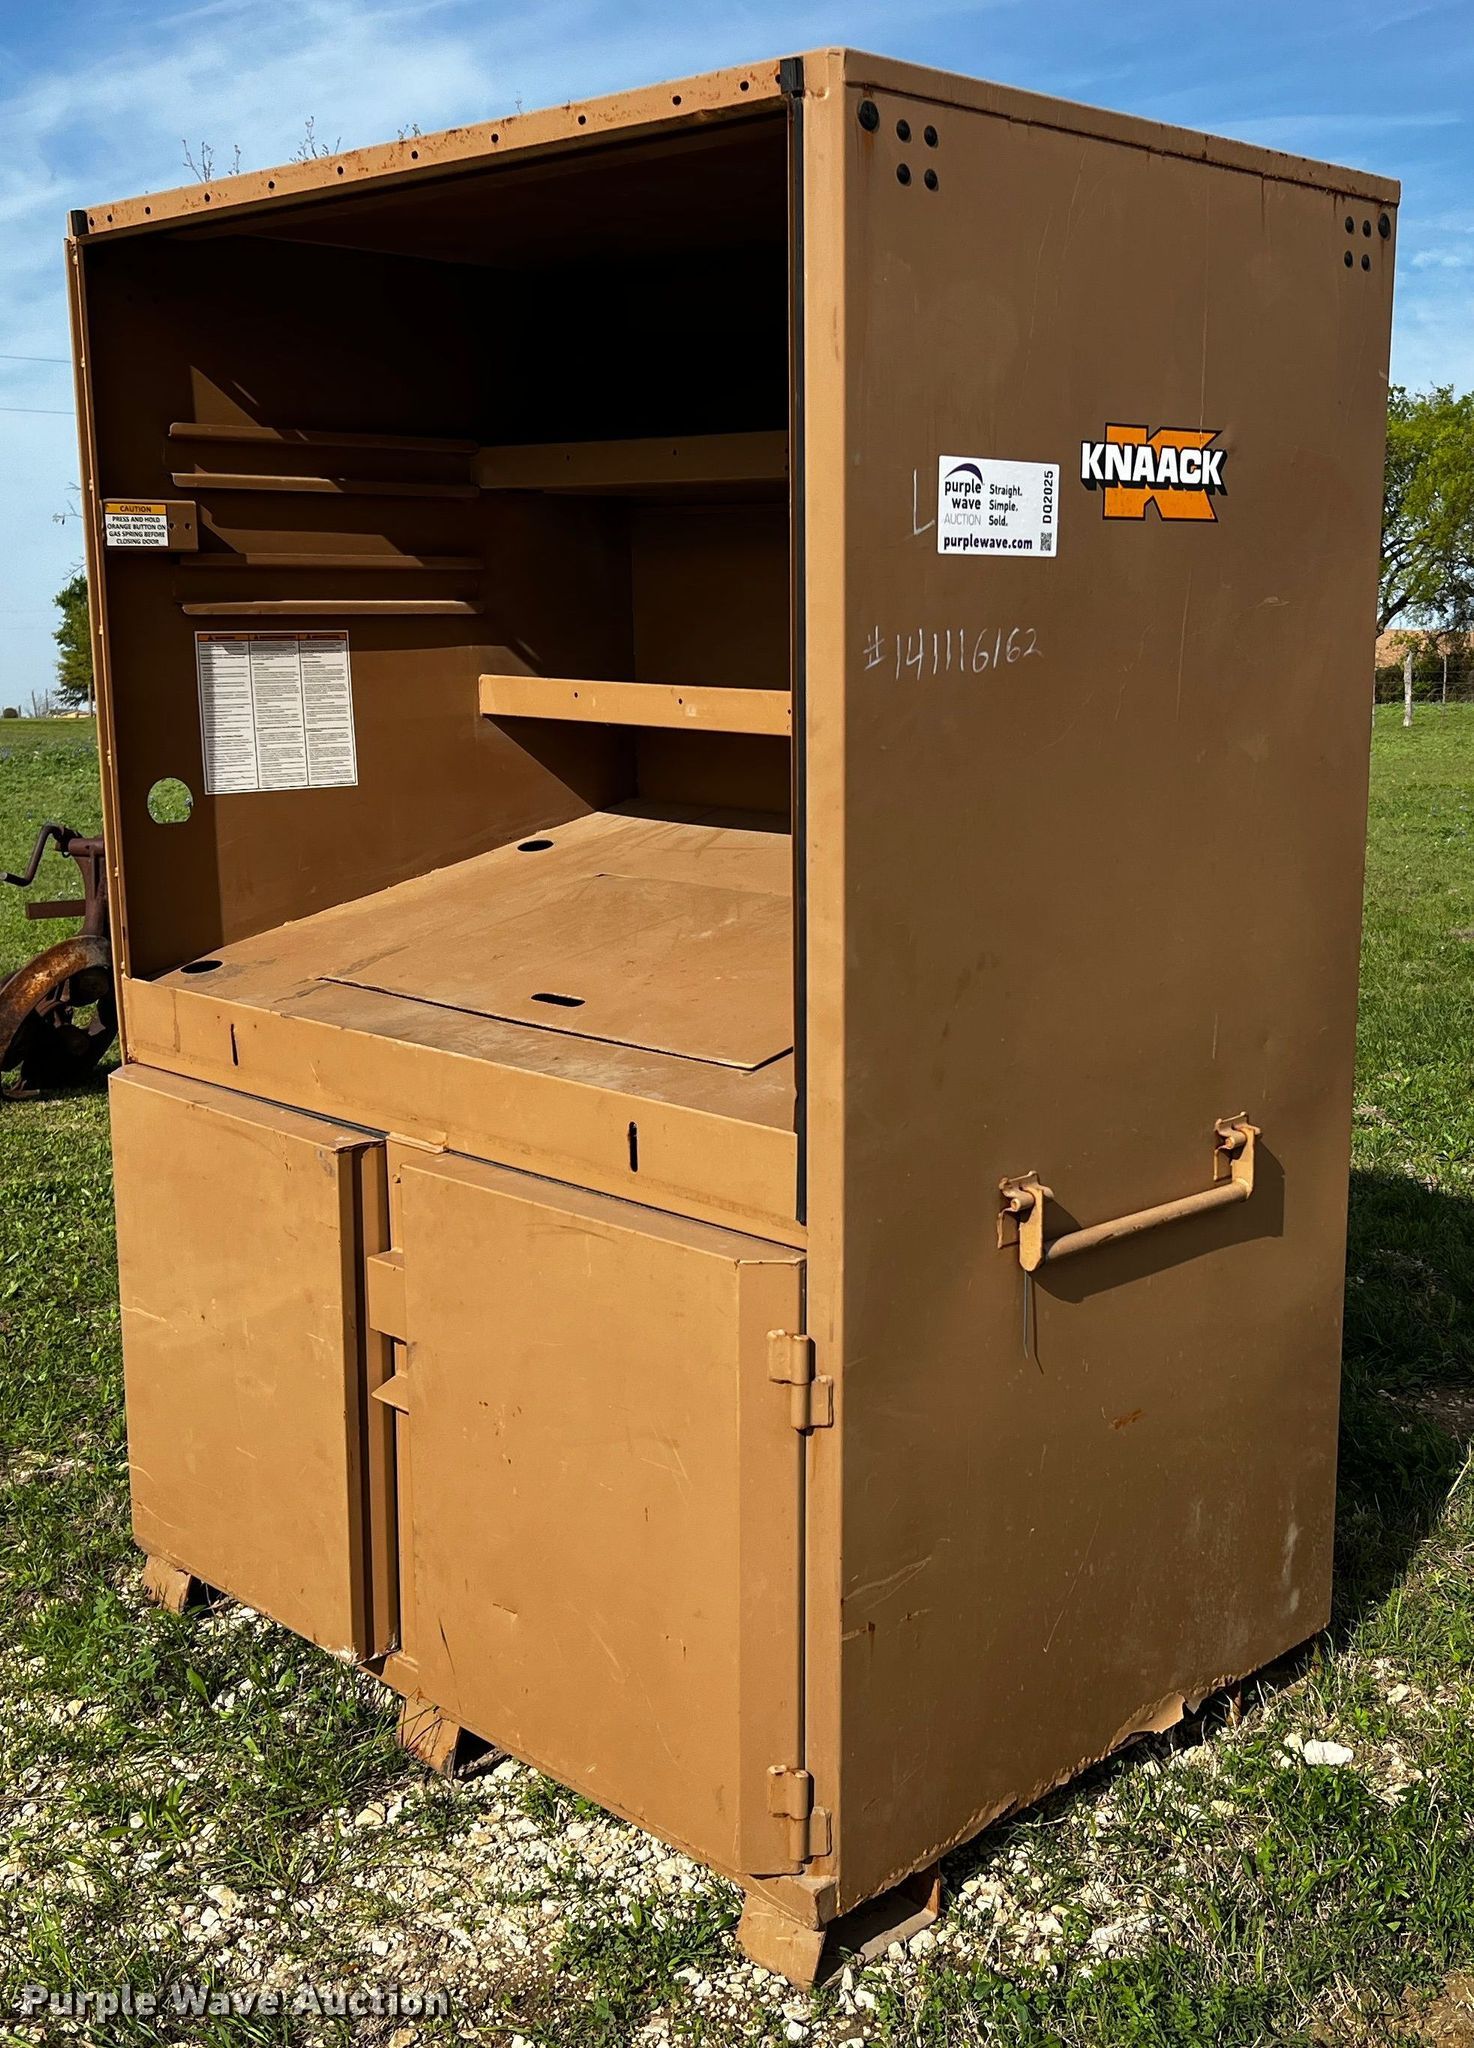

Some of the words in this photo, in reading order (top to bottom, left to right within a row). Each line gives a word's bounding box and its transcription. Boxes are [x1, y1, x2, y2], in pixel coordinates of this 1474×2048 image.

[1081, 441, 1226, 492] KNAACK
[945, 478, 982, 497] purple
[989, 484, 1023, 498] Straight.
[952, 498, 981, 510] wave
[1042, 470, 1054, 524] DQ2025
[989, 500, 1018, 513] Simple.
[944, 513, 981, 526] AUCTION
[988, 515, 1008, 527] Sold.
[943, 533, 1033, 551] purplewave.com
